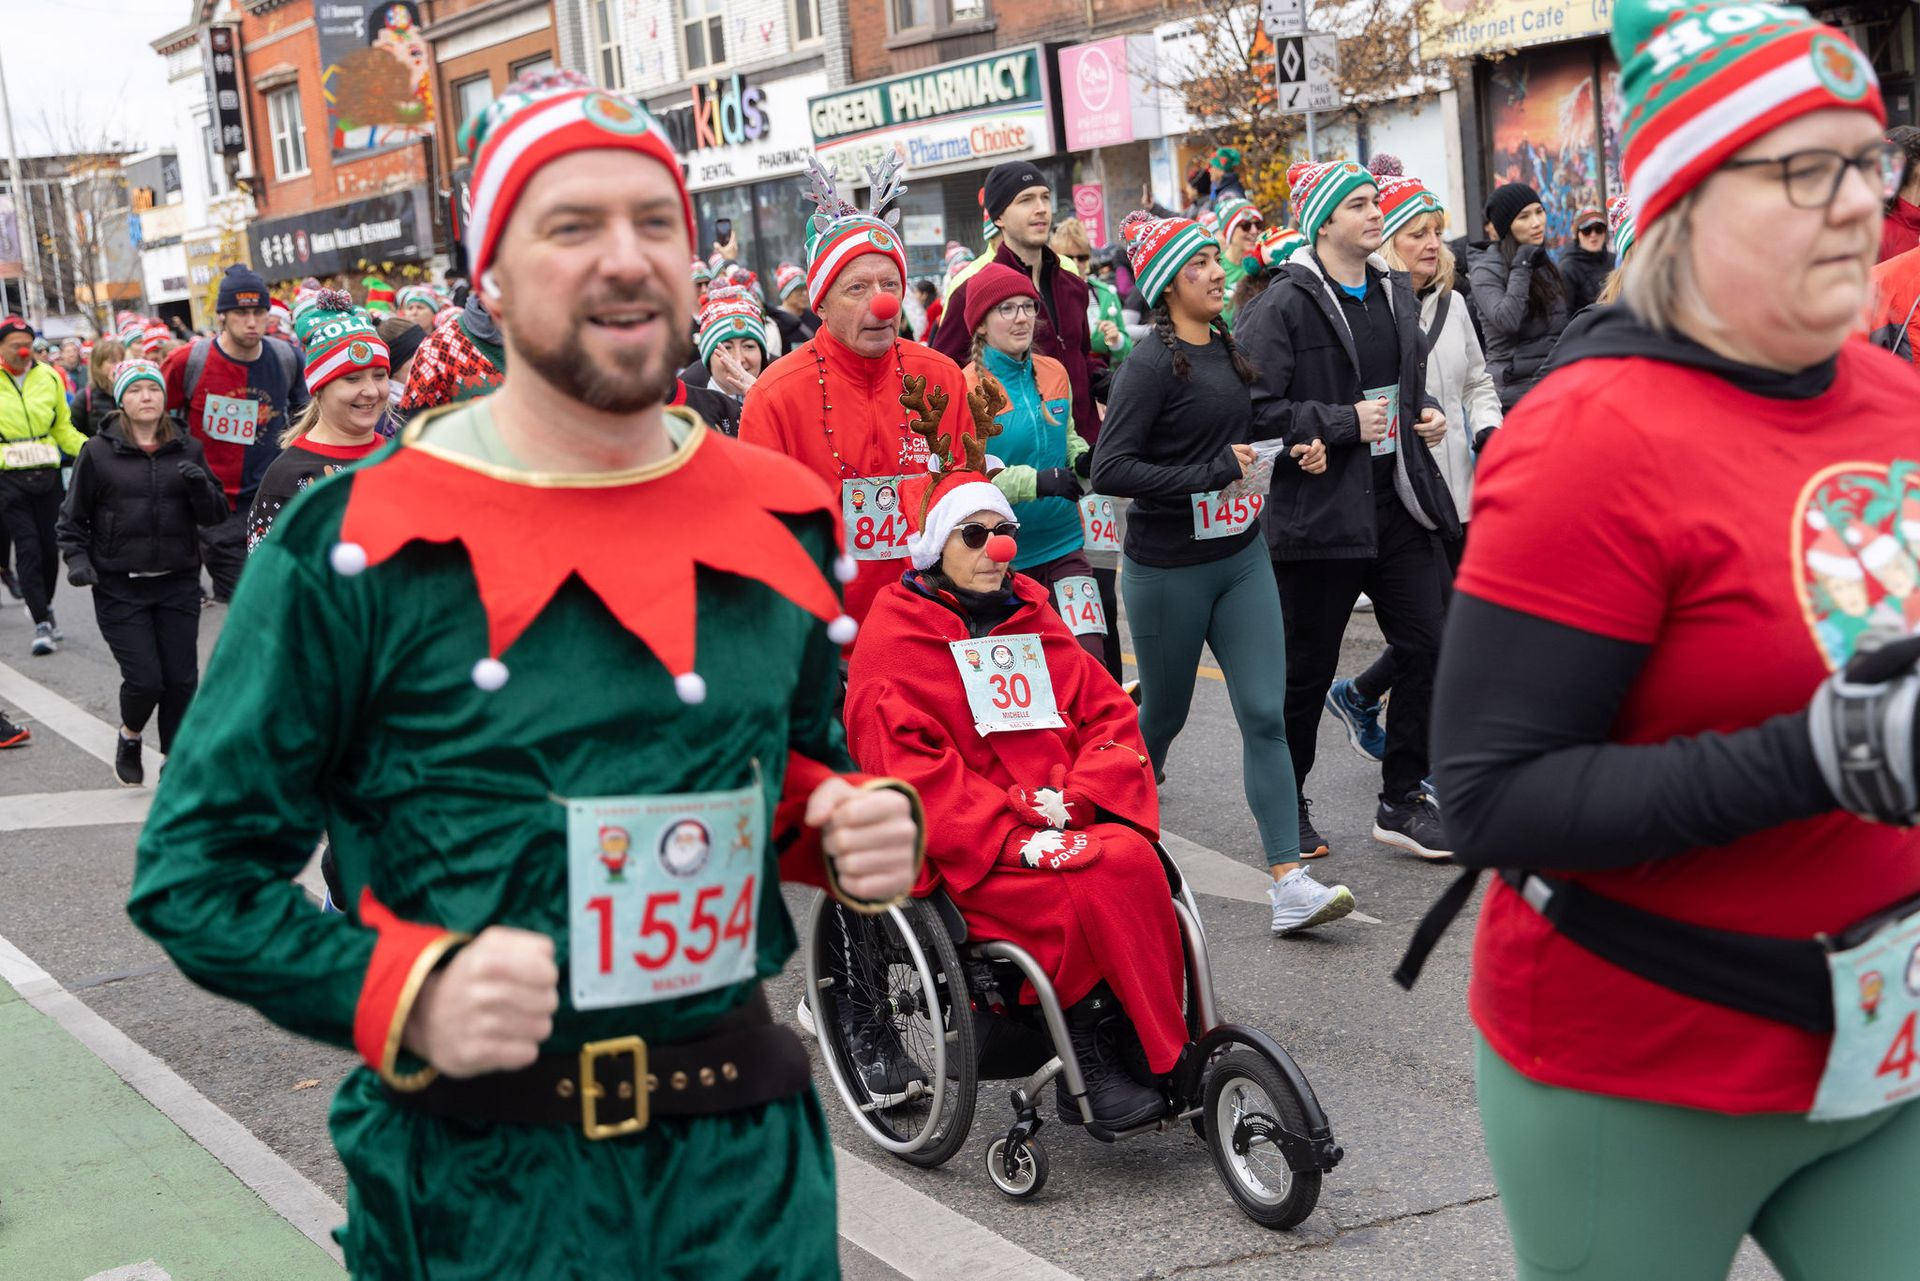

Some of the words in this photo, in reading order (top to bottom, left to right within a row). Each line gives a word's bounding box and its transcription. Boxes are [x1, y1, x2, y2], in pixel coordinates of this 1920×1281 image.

[811, 88, 884, 138] GREEN
[889, 53, 1029, 122] PHARMACY
[908, 124, 1026, 165] PharmaChoice
[702, 163, 735, 181] DENTAL
[758, 147, 810, 169] PHARMACY
[207, 414, 255, 438] 1818
[1197, 492, 1263, 529] 1459
[854, 513, 909, 551] 842
[989, 672, 1032, 710] 30
[1002, 710, 1031, 719] MICHELLE
[585, 872, 756, 976] 1554
[1874, 1009, 1920, 1080] 4
